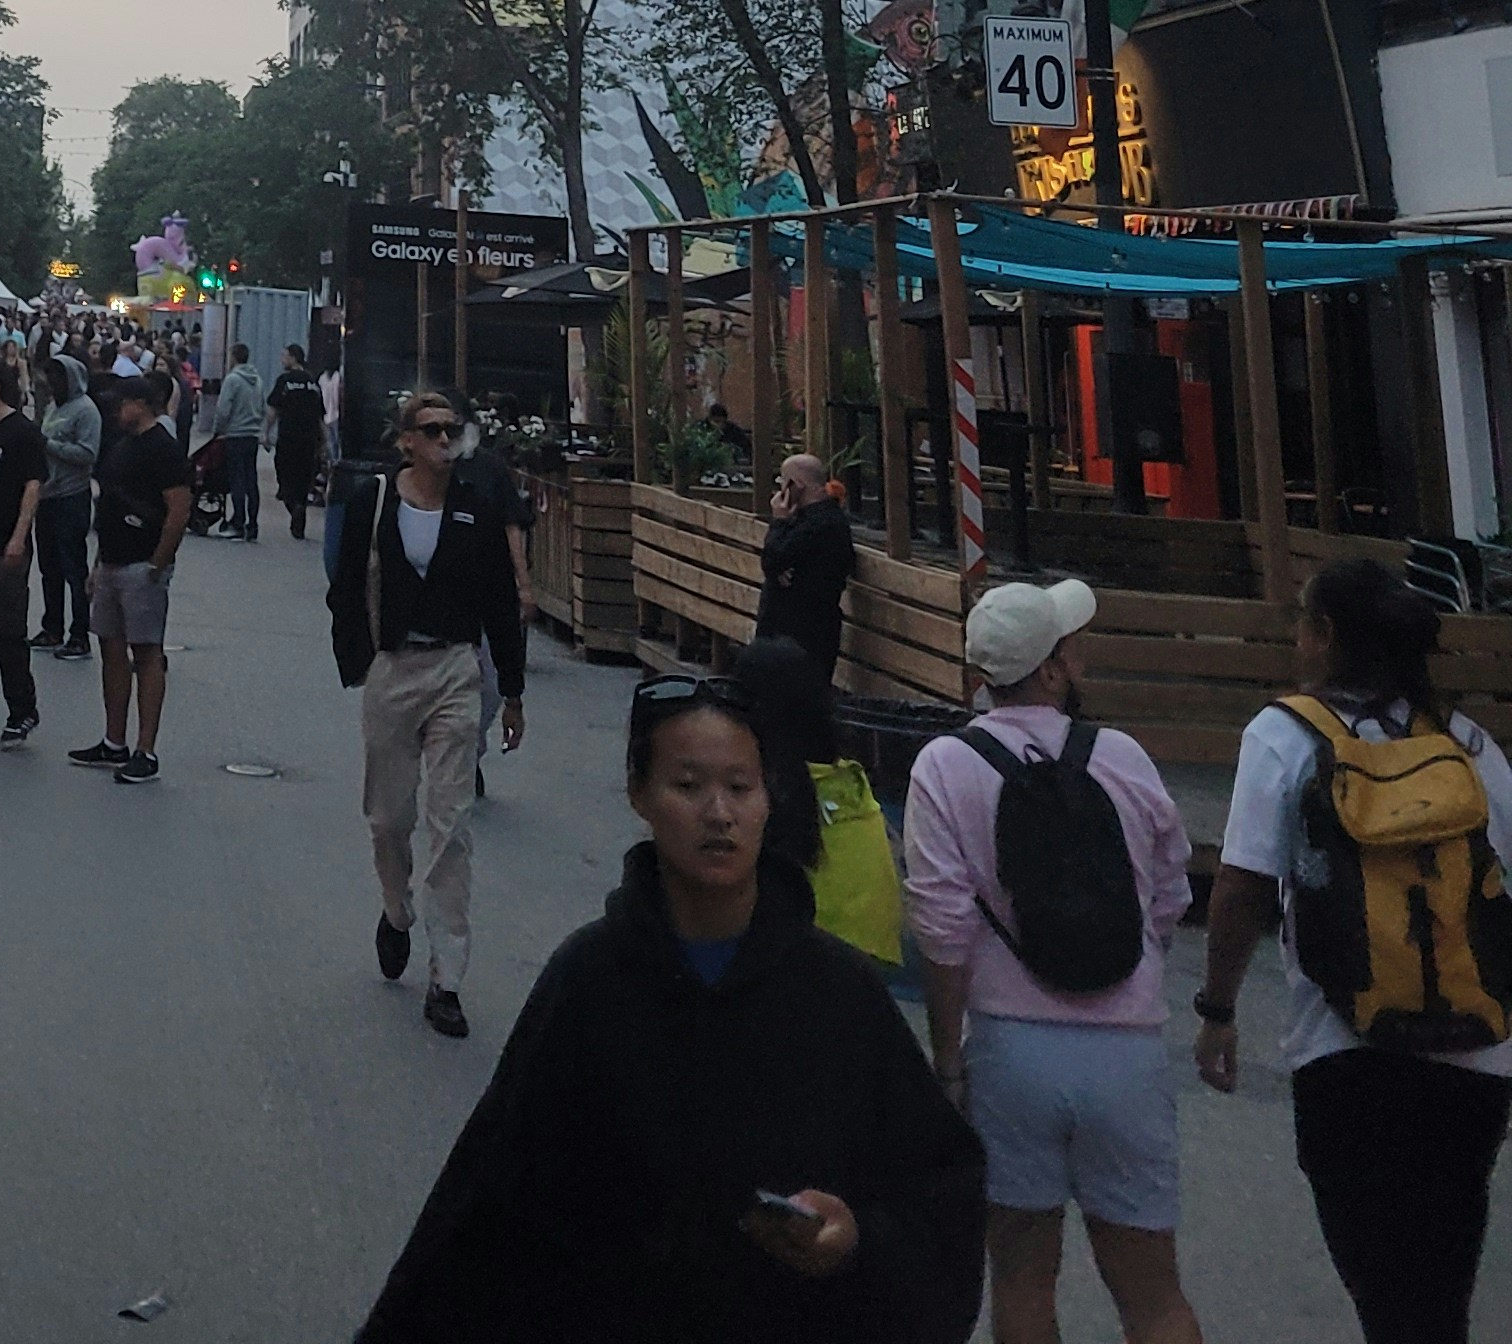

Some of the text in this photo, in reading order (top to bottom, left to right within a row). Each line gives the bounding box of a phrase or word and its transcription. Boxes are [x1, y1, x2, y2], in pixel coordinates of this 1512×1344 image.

[993, 26, 1064, 43] MAXIMUM
[998, 54, 1066, 110] 40
[371, 224, 420, 237] SAMSUNG
[428, 228, 458, 239] Galax
[486, 233, 502, 242] est
[371, 240, 444, 266] Galaxy
[477, 245, 535, 269] fleurs
